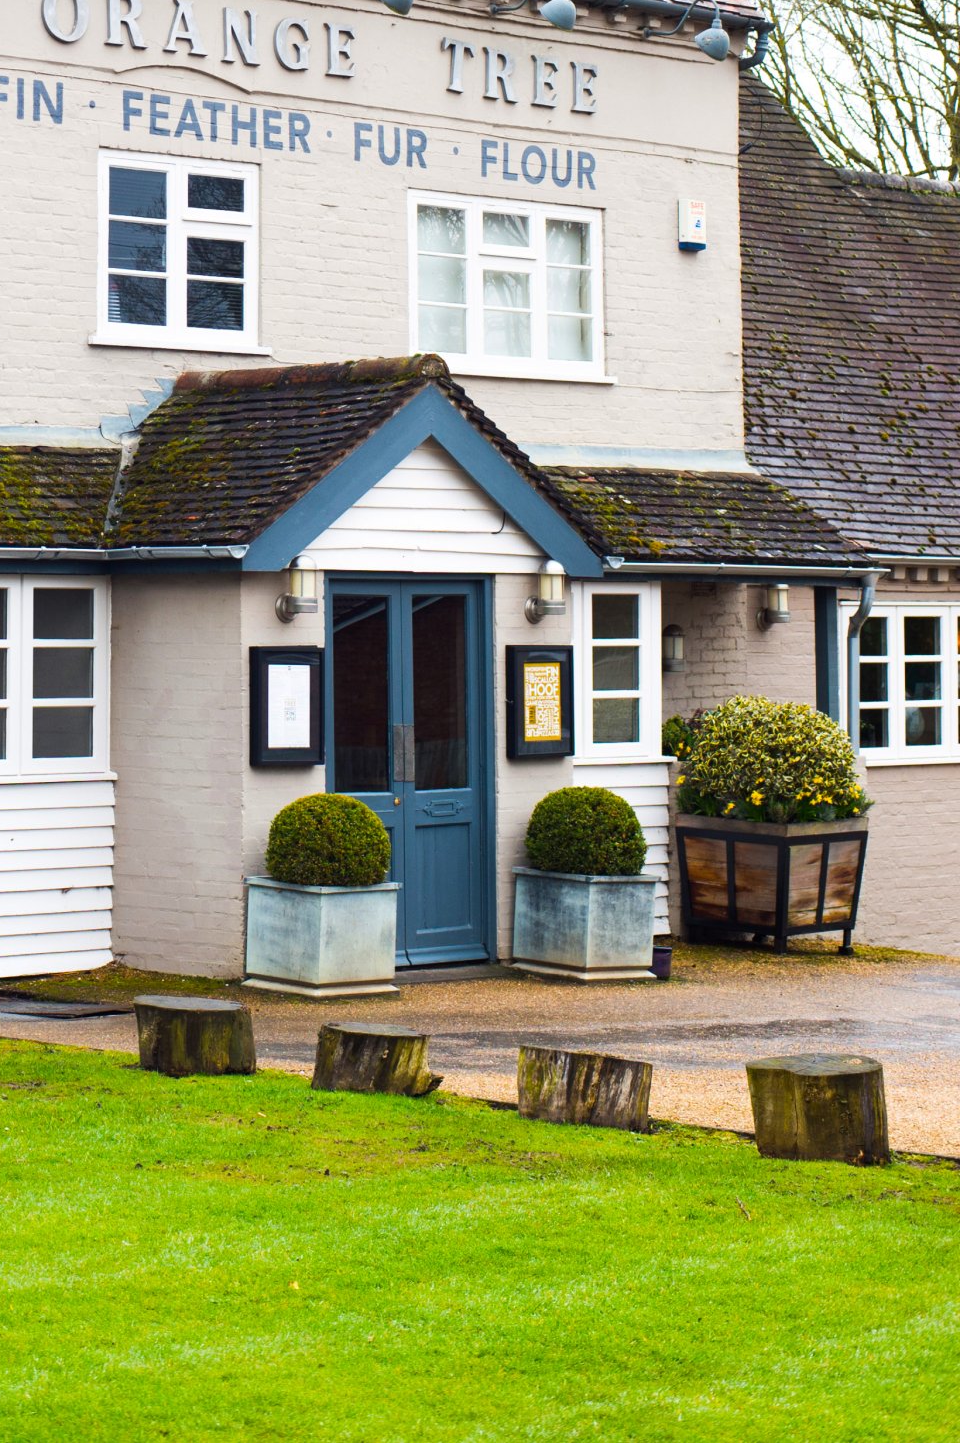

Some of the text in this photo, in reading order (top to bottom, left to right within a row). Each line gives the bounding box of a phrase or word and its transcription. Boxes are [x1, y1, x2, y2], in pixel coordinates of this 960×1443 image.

[441, 36, 599, 115] TREE
[122, 90, 312, 154] FEATHER
[353, 122, 428, 169] FUR
[480, 139, 597, 191] FLOUR
[529, 683, 559, 696] HOOF
